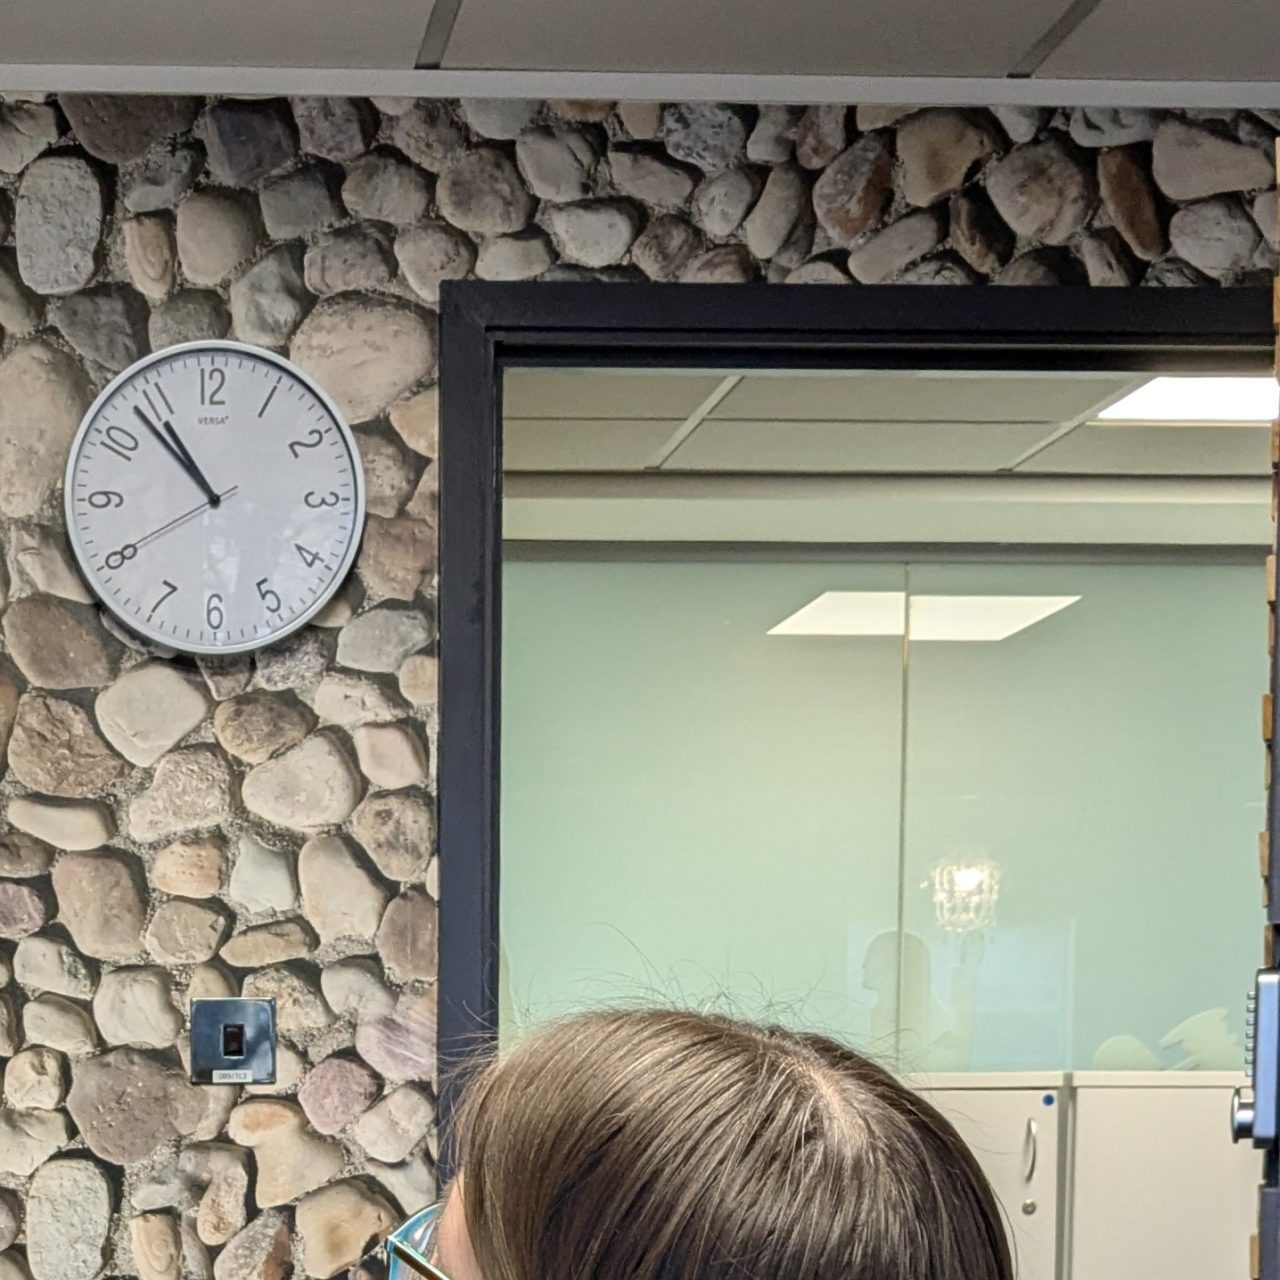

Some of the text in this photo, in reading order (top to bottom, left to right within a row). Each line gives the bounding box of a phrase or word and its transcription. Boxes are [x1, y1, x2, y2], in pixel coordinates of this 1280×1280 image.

[200, 368, 226, 406] 12
[100, 426, 138, 462] 10
[288, 429, 323, 458] 2
[88, 491, 123, 509] 9
[304, 491, 340, 509] 3
[105, 544, 138, 570] 8
[294, 543, 325, 568] 4
[151, 580, 177, 613] 7
[255, 578, 281, 613] 5
[207, 593, 223, 630] 6
